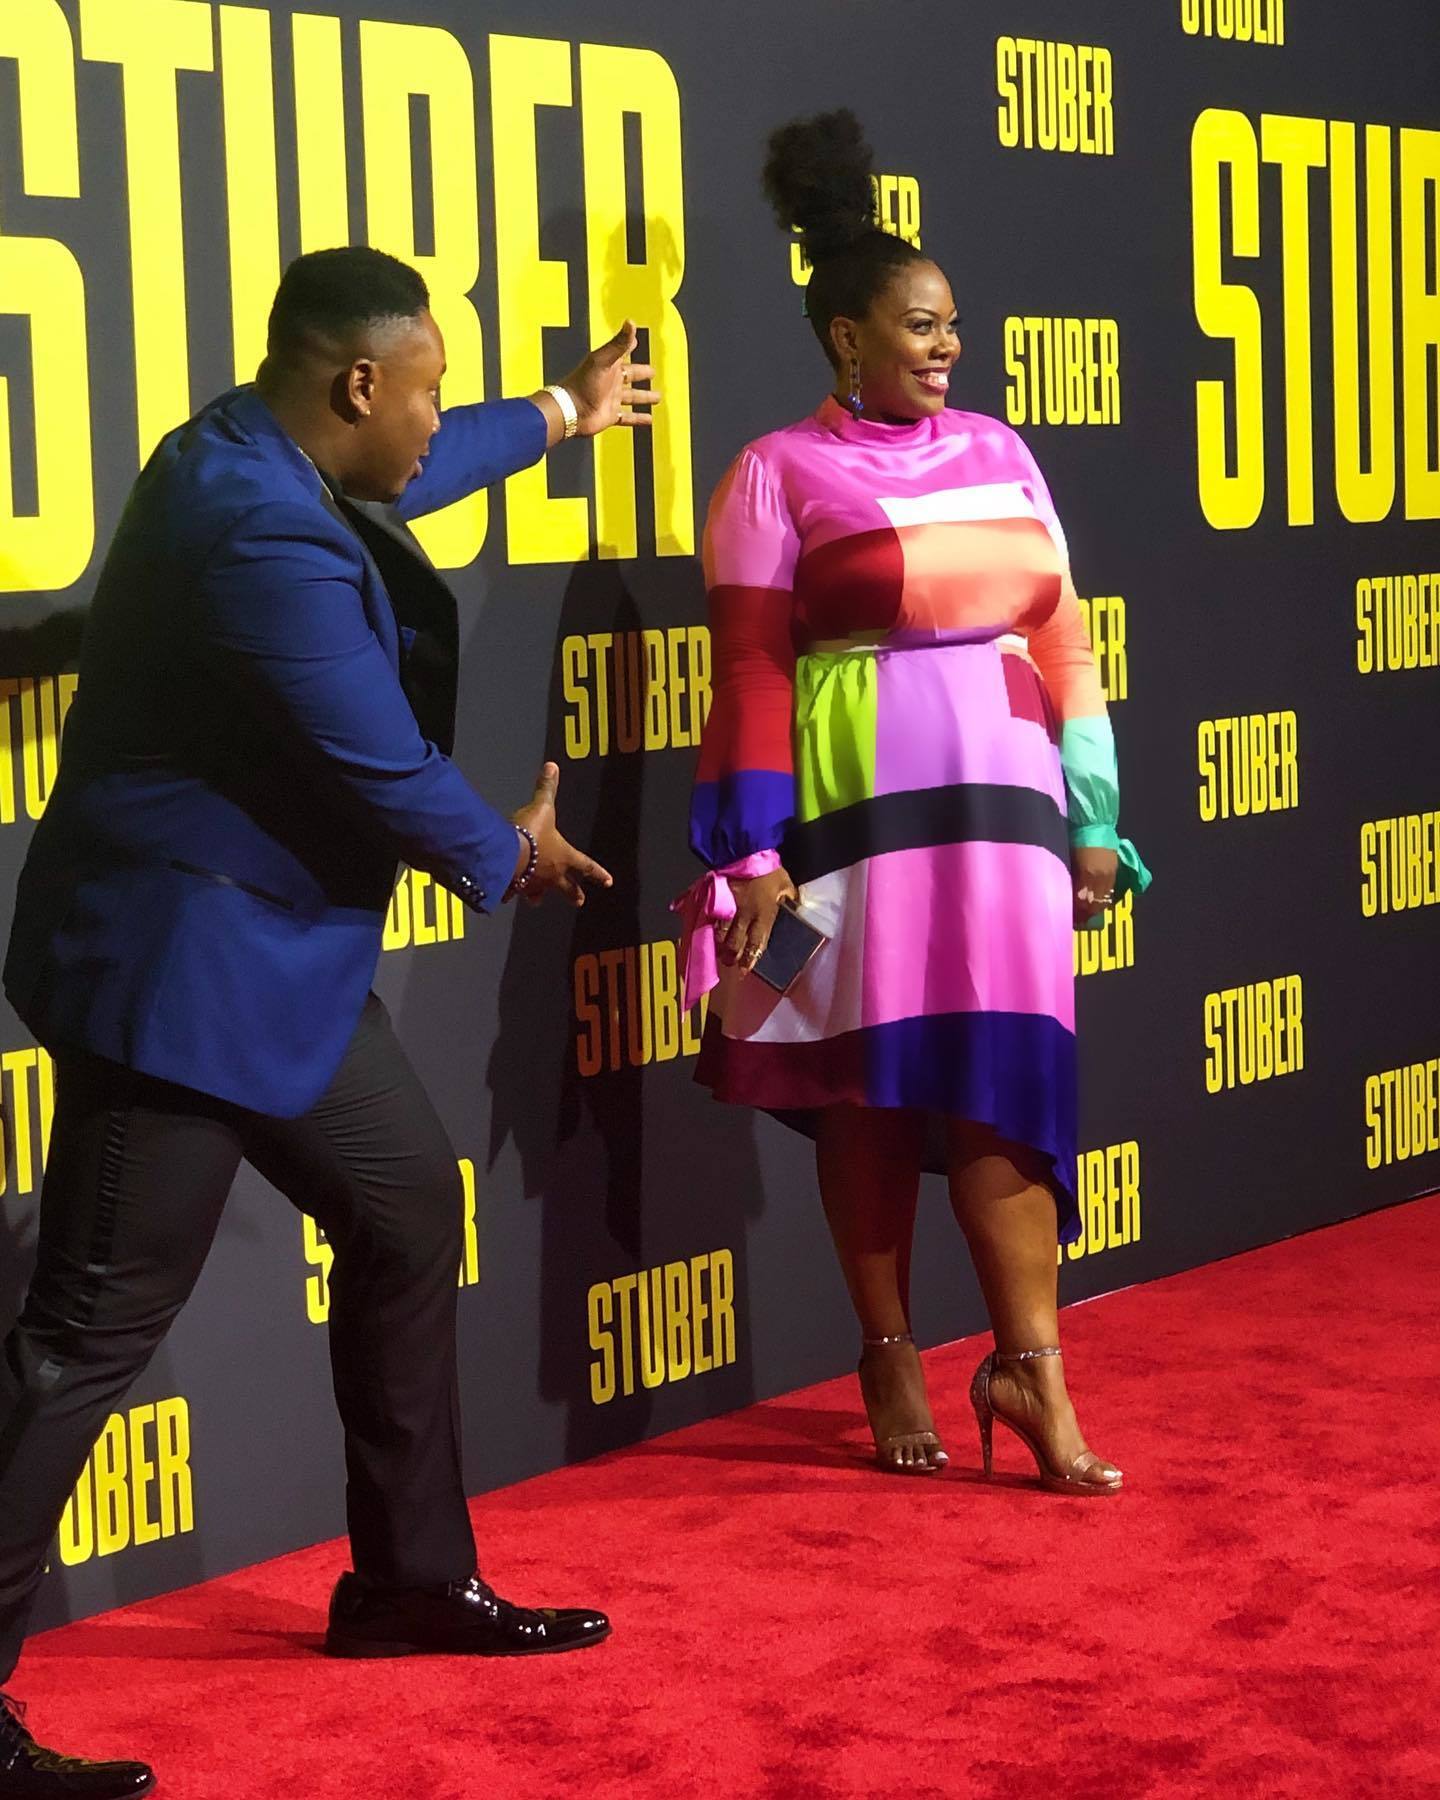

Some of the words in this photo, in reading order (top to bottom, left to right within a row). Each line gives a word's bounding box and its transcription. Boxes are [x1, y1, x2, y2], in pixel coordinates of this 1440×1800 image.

[996, 36, 1114, 155] STUBER
[1004, 316, 1121, 425] STUBER
[562, 625, 713, 760] STUBER
[1198, 711, 1298, 822] STUBER
[575, 939, 710, 1077] STUB
[1204, 974, 1304, 1094] STUBER
[1365, 1057, 1440, 1170] STUBE
[588, 1248, 736, 1404] STUBER
[45, 1396, 194, 1572] UBER
